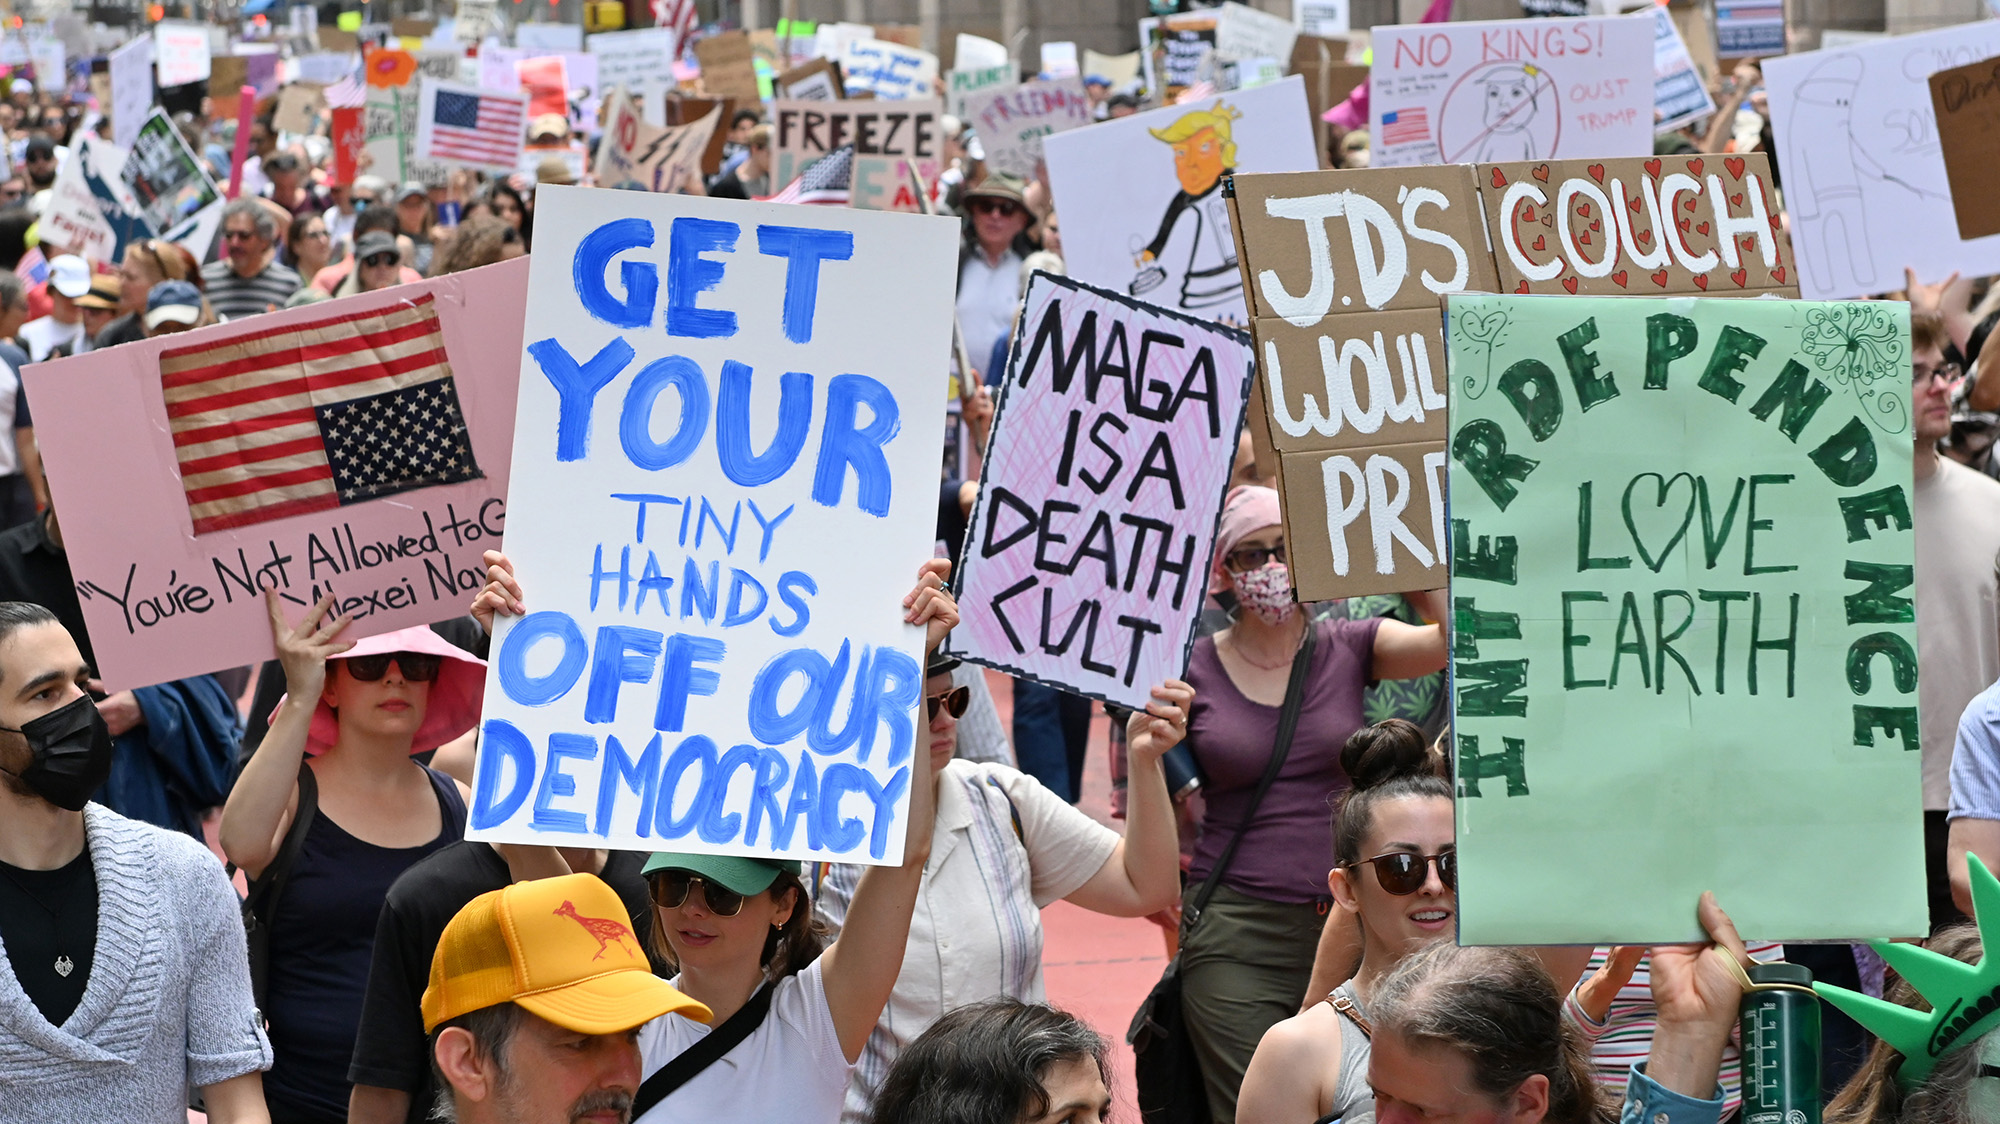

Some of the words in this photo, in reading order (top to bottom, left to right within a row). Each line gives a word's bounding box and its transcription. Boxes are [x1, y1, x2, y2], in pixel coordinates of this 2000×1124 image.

[1394, 33, 1452, 69] NO
[1482, 22, 1604, 61] KINGS!
[1570, 78, 1630, 103] OUST
[779, 110, 933, 157] FREEZE
[1576, 107, 1638, 132] TRUMP
[1500, 173, 1782, 280] COUCH
[573, 217, 854, 344] GET
[1018, 299, 1220, 439] MAGA
[1265, 330, 1447, 438] WOUL
[527, 336, 902, 518] YOUR
[1056, 408, 1129, 495] IS
[1125, 431, 1186, 510] A
[212, 540, 293, 603] Not
[308, 510, 443, 580] Allowed
[440, 503, 482, 547] to
[611, 492, 795, 564] TINY
[981, 486, 1196, 610] DEATH
[1452, 312, 1920, 799] INTERDEPENDENCE
[1577, 471, 1798, 576] LOVE
[589, 542, 819, 638] HANDS
[990, 574, 1163, 689] CULT
[1561, 589, 1800, 698] EARTH
[499, 610, 728, 733] OFF
[747, 637, 922, 768] OUR
[471, 718, 910, 861] DEMOCRACY
